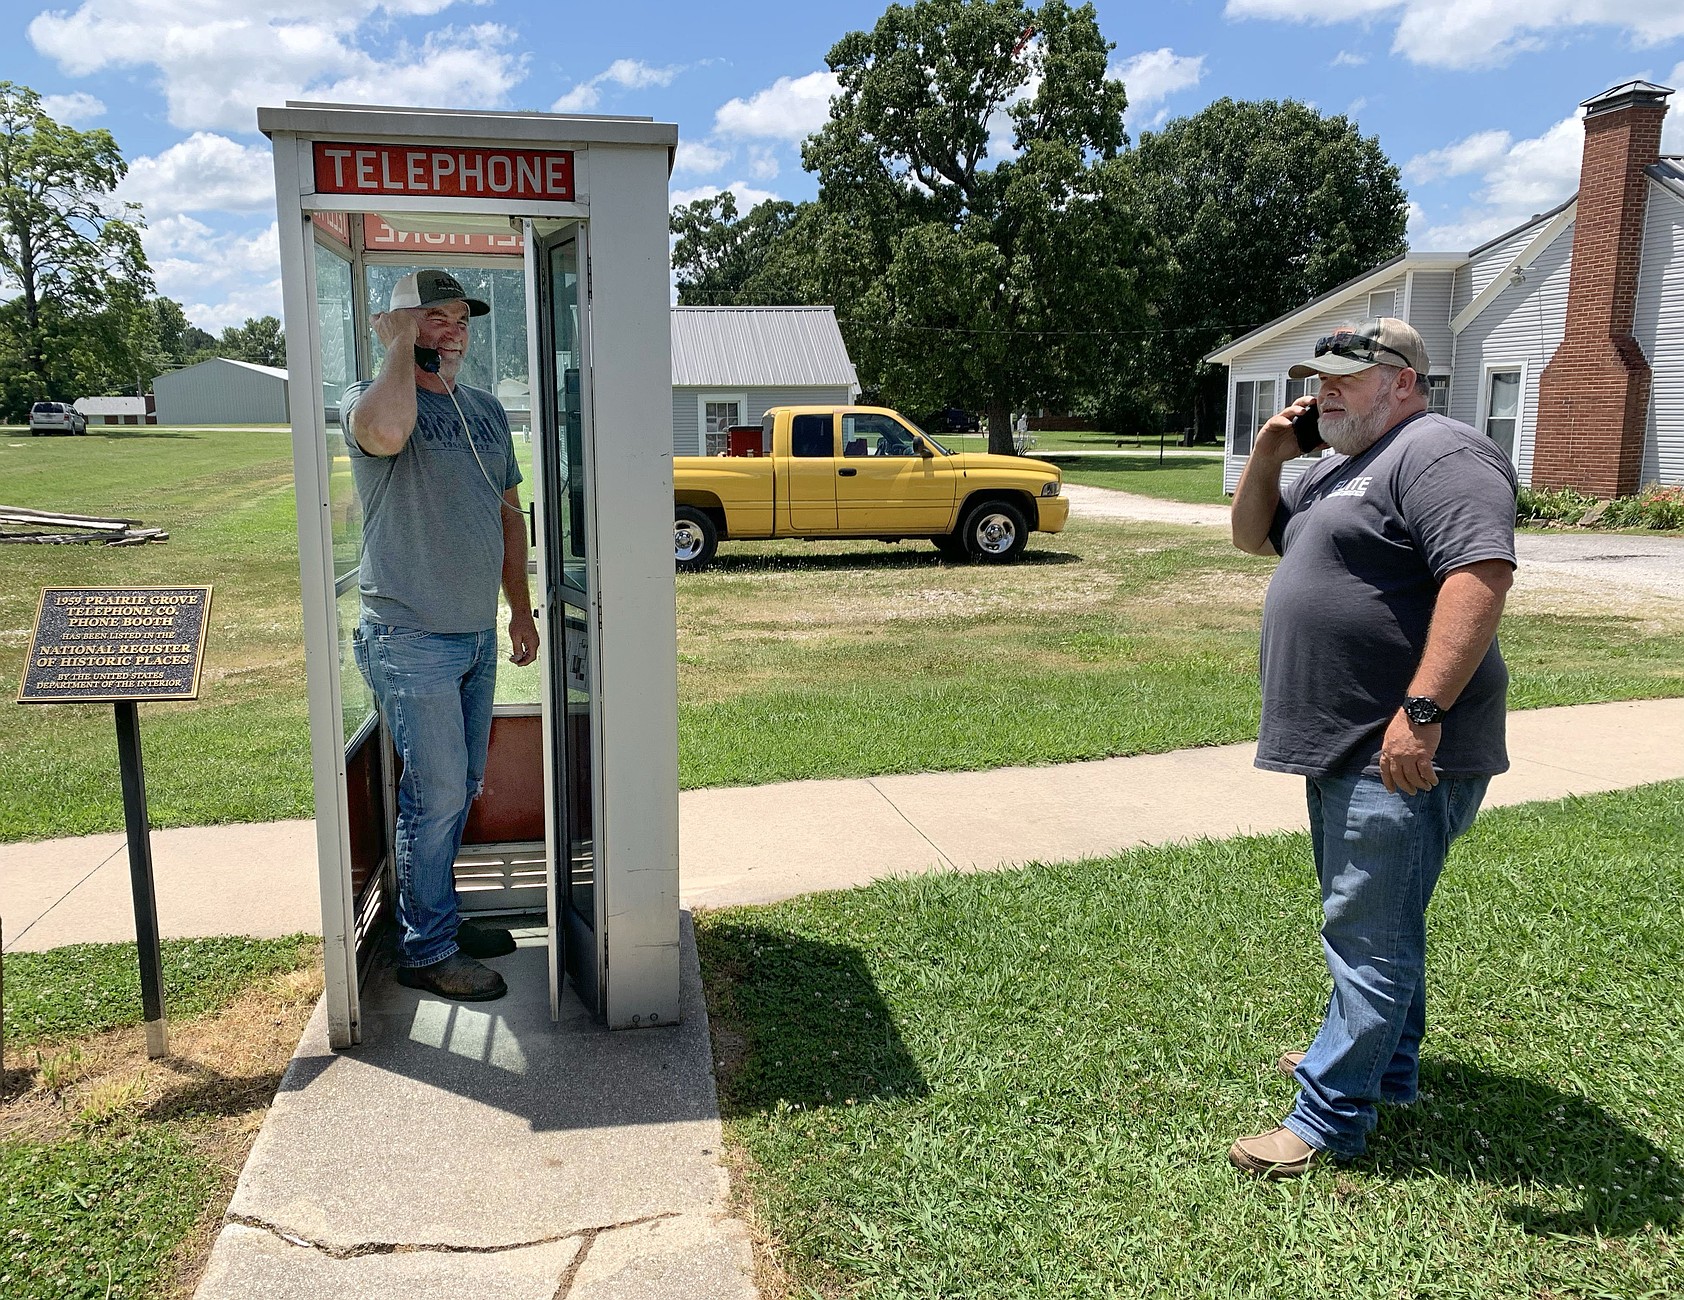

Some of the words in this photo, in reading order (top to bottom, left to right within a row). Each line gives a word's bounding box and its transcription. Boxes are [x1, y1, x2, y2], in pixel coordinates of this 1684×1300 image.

[325, 149, 567, 194] TELEPHONE
[55, 596, 82, 606] 1959
[84, 595, 147, 605] PRAIRIE
[149, 595, 198, 605] GROVE
[66, 606, 153, 617] TELEPHONE
[156, 606, 180, 616] CO.
[68, 617, 120, 628] PHONE
[121, 617, 174, 627] BOOTH
[156, 631, 176, 639] THE
[39, 645, 115, 655] NATIONAL
[117, 644, 192, 654] REGISTER
[36, 657, 58, 668] OF
[59, 656, 132, 667] HISTORIC
[134, 655, 190, 666] PLACES
[57, 673, 71, 681] BY
[71, 673, 92, 681] THE
[93, 672, 129, 680] UNITED
[130, 671, 165, 680] STATES
[36, 681, 101, 690] DEPARTMENT
[101, 680, 116, 688] OF
[115, 680, 136, 688] THE
[136, 679, 182, 688] INTERIOR
